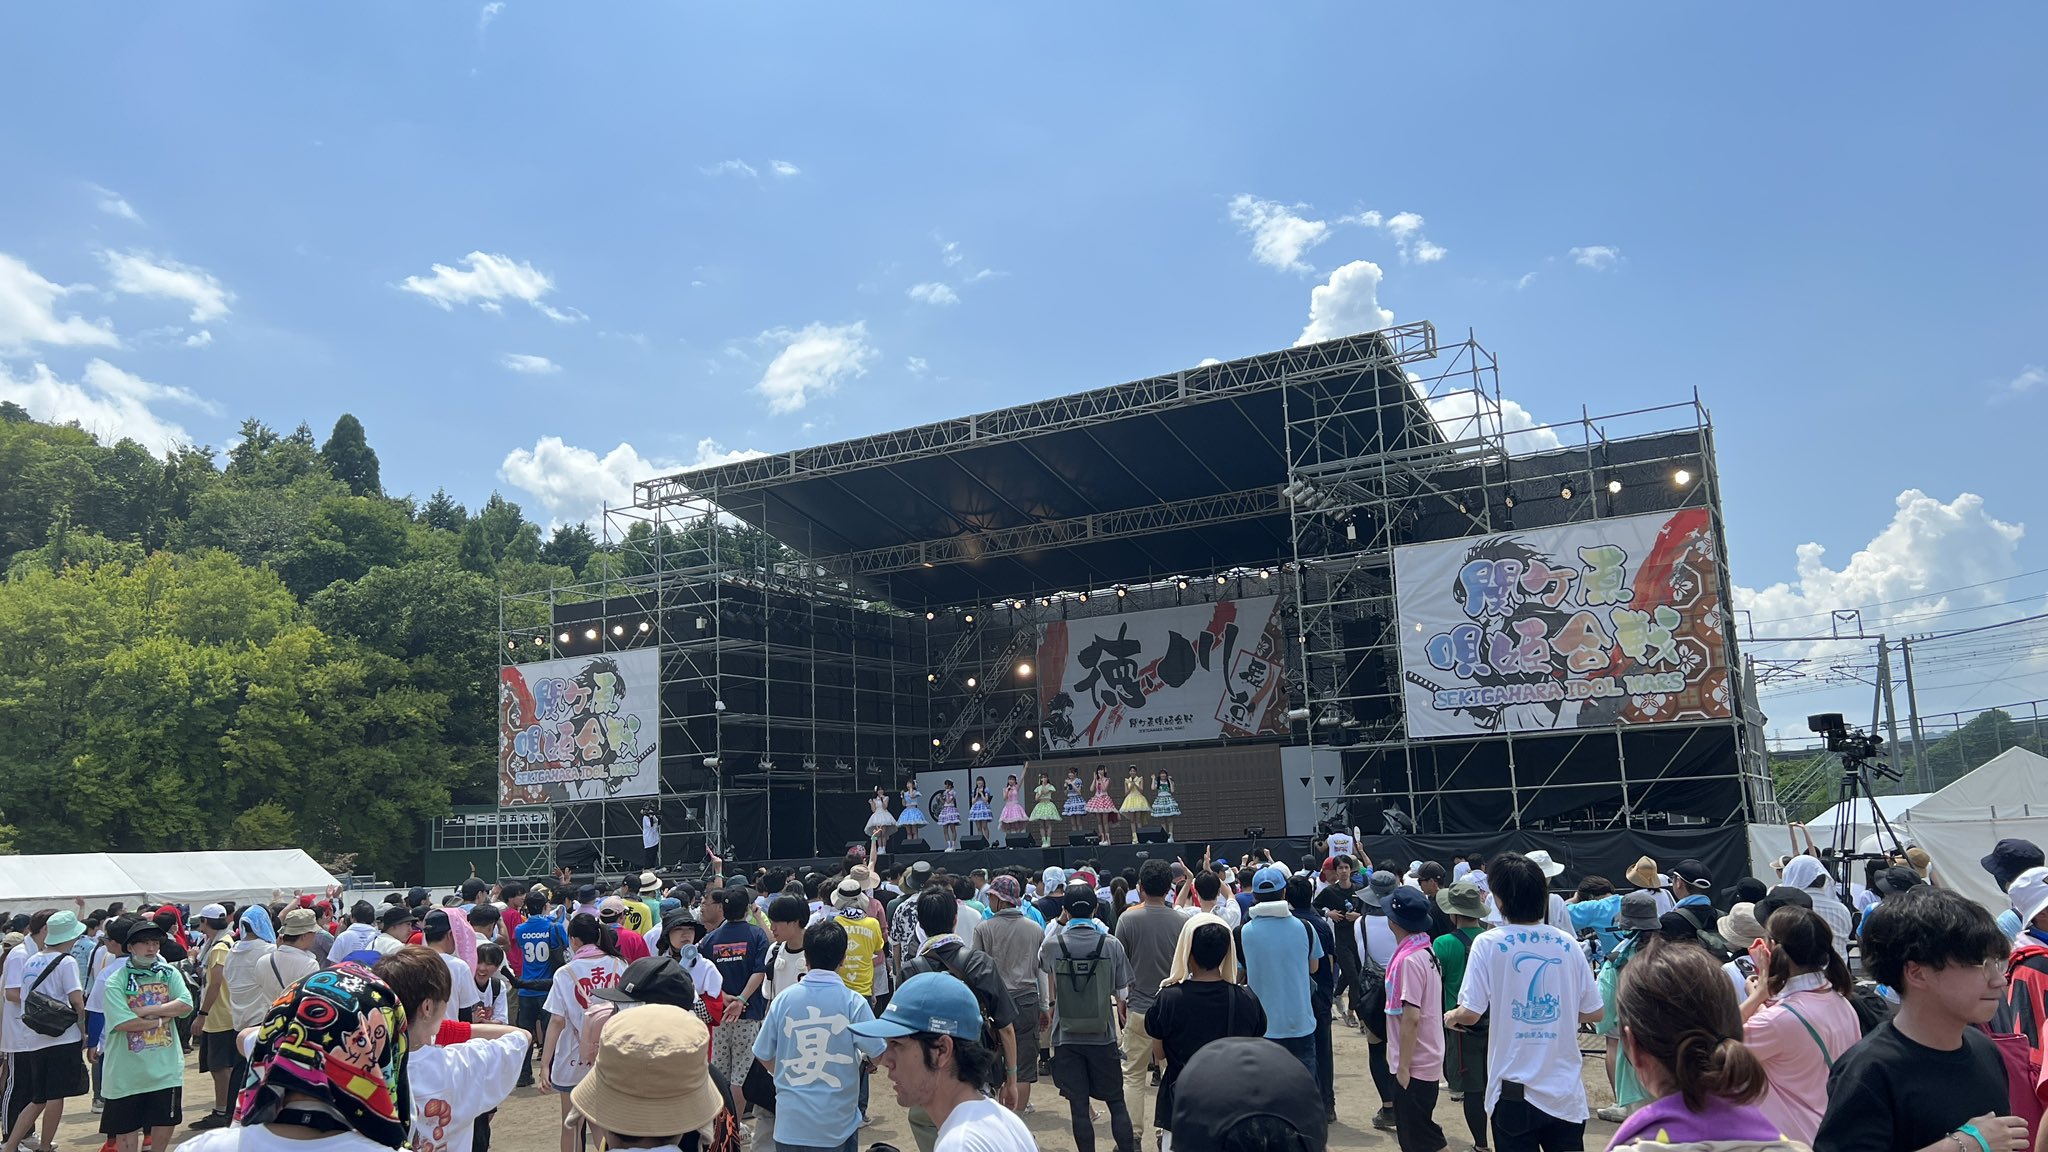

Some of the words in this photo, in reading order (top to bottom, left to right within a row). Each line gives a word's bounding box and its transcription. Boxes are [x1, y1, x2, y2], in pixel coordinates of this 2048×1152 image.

[1073, 621, 1239, 709] 徳川
[1424, 604, 1683, 679] 唄姫合戦
[1433, 681, 1564, 710] SEKIGAHARA
[1565, 677, 1624, 701] IDOL
[1622, 672, 1686, 695] WARS
[513, 714, 641, 763] 唄姫合戦
[515, 768, 579, 785] SEKIGAHARA
[580, 765, 609, 780] IDOL
[609, 762, 639, 777] WARS
[524, 941, 550, 963] 30
[781, 1006, 853, 1088] 宴
